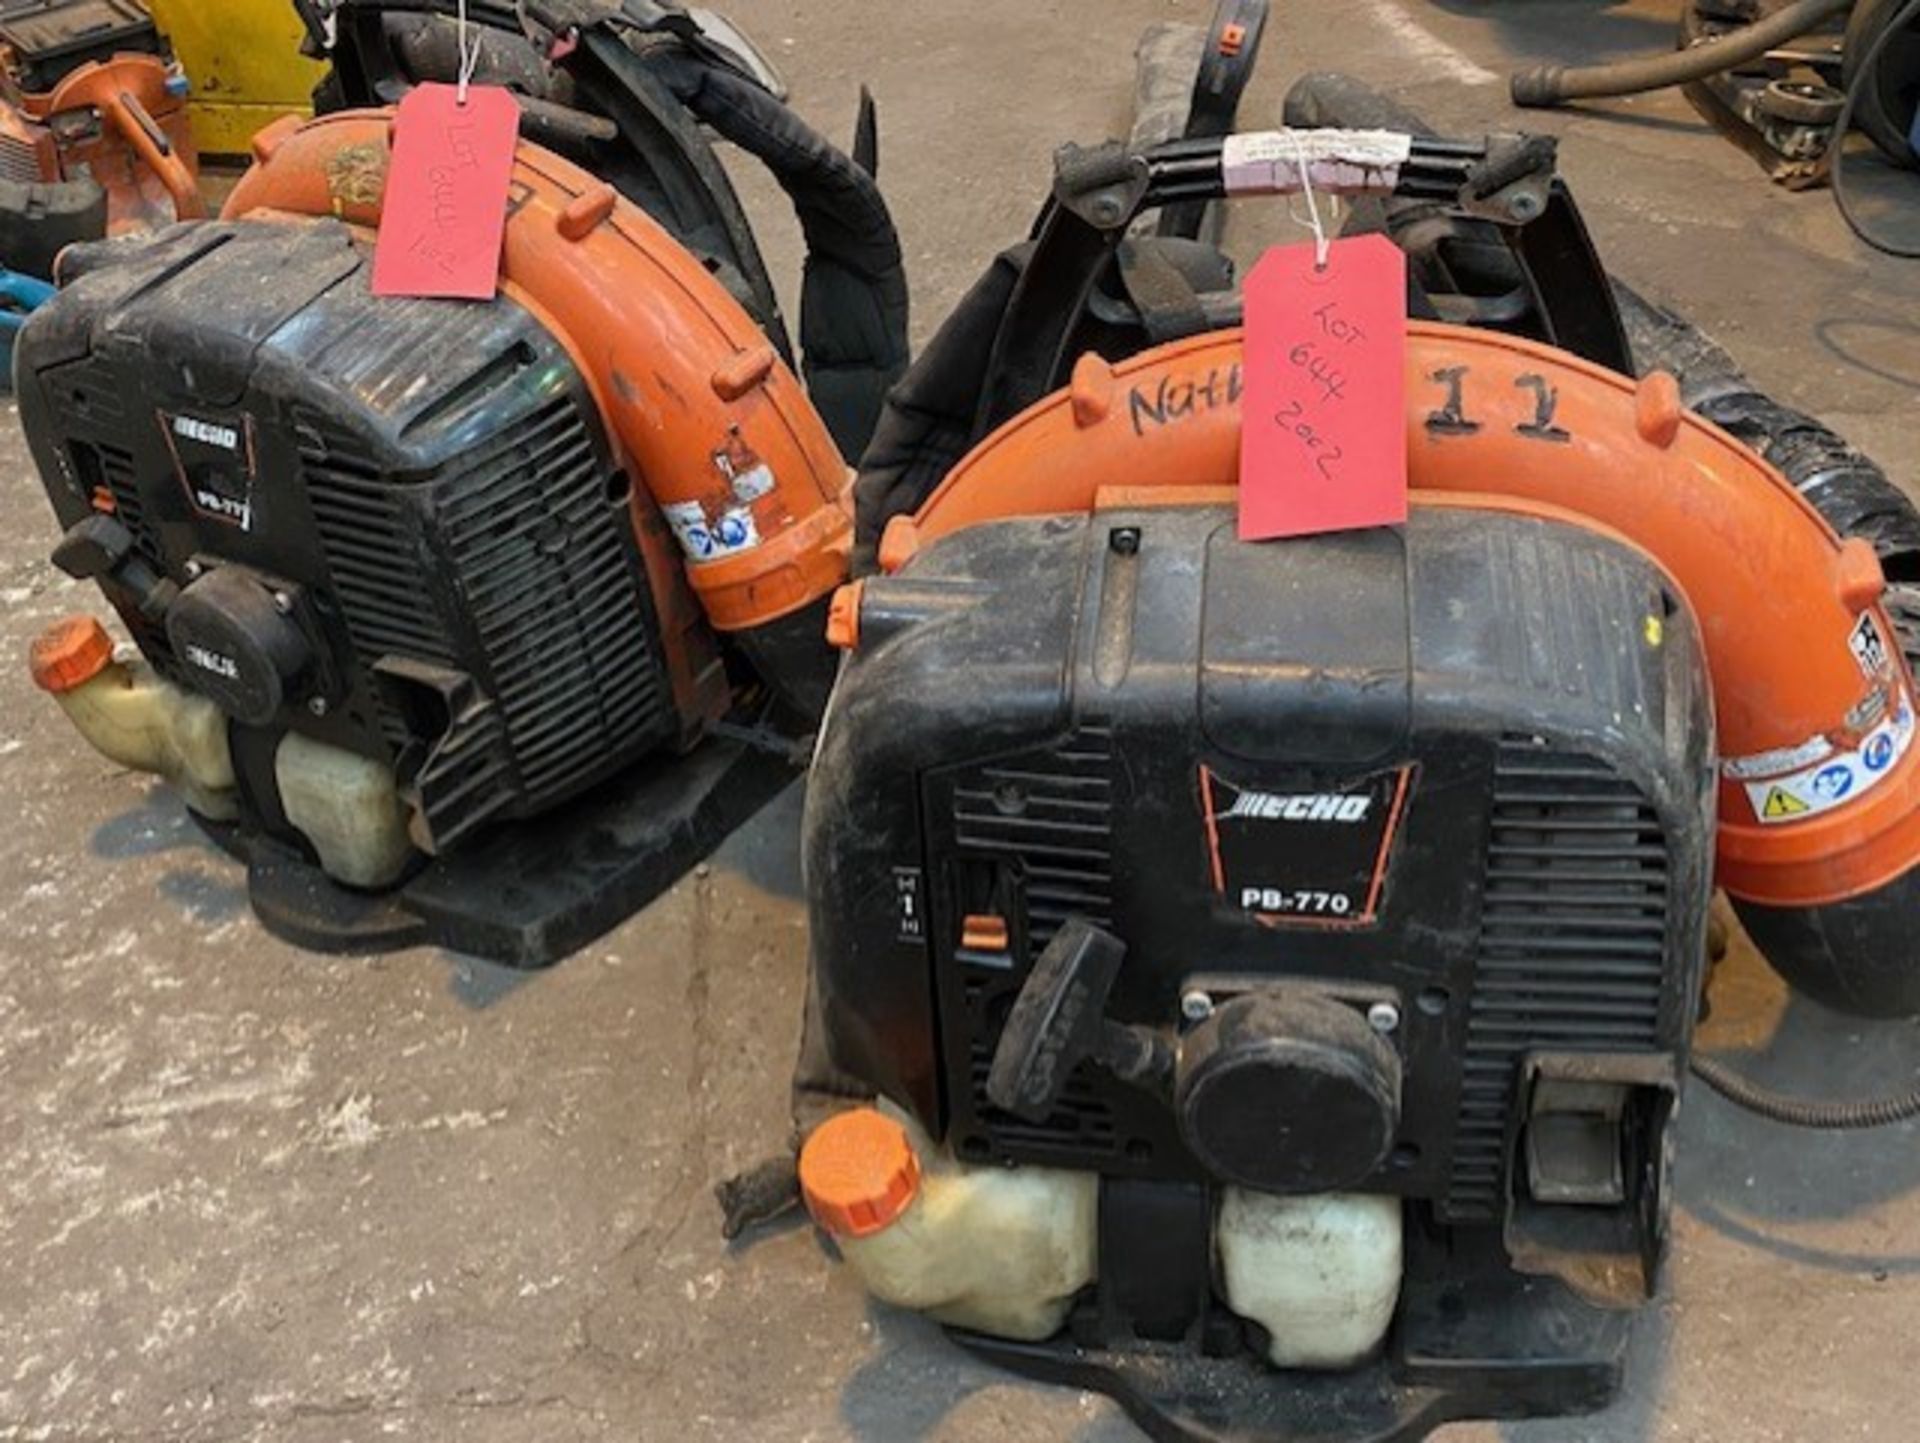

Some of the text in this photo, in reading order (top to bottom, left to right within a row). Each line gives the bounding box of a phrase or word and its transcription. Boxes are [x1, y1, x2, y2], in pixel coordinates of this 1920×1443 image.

[1313, 302, 1367, 345] LOT
[1289, 341, 1346, 402] 644
[1256, 792, 1372, 822] ECHO
[1241, 887, 1350, 913] PB-770
